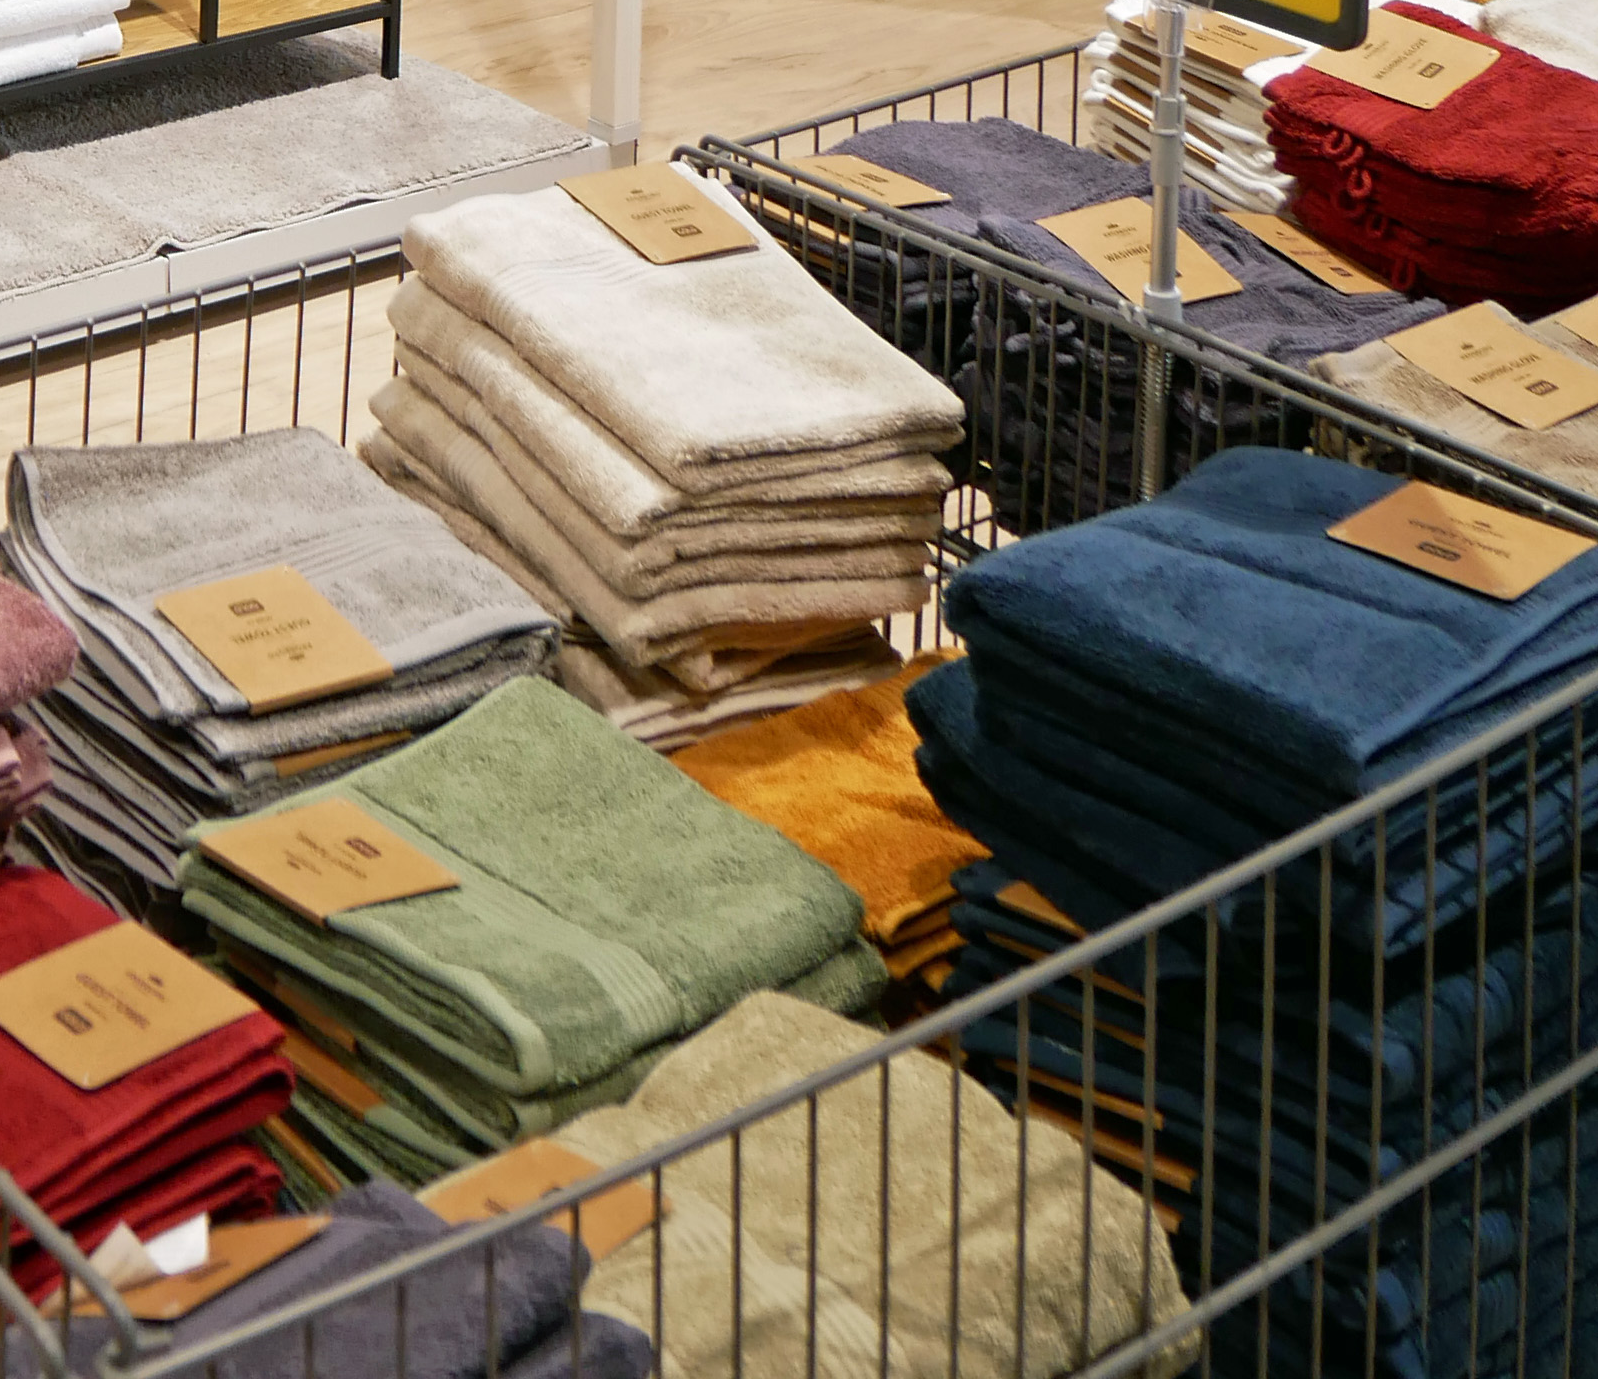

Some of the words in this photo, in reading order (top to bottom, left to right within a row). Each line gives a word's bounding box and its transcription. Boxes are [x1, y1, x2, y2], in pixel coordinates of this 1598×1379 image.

[631, 209, 661, 222] GUEST
[662, 203, 695, 216] TOWEL
[1104, 244, 1148, 263] WASHING
[1468, 362, 1513, 385] WASHING
[1512, 352, 1542, 371] GLOVE
